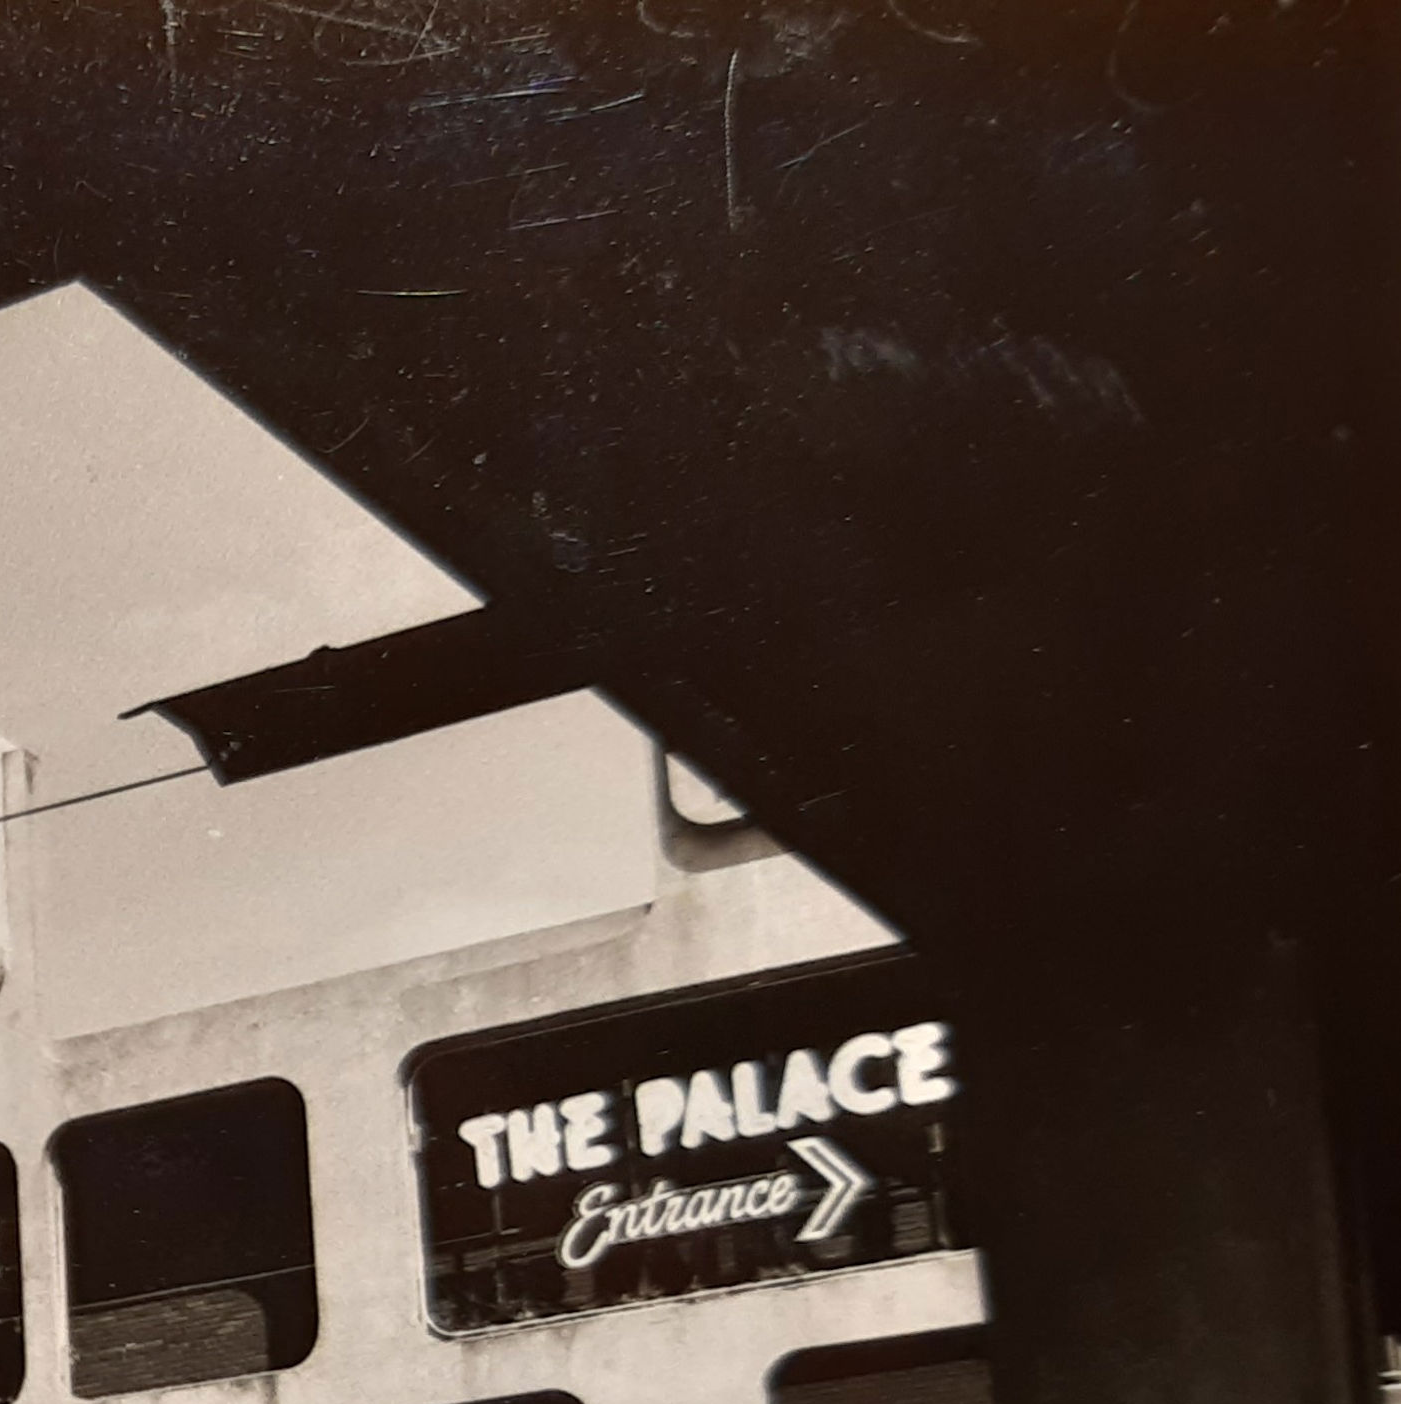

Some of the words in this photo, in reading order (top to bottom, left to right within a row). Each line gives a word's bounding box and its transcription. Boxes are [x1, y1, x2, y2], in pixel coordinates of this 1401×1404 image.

[457, 1091, 620, 1190] THE
[634, 1020, 959, 1157] PALACE
[558, 1171, 800, 1269] Entrance
